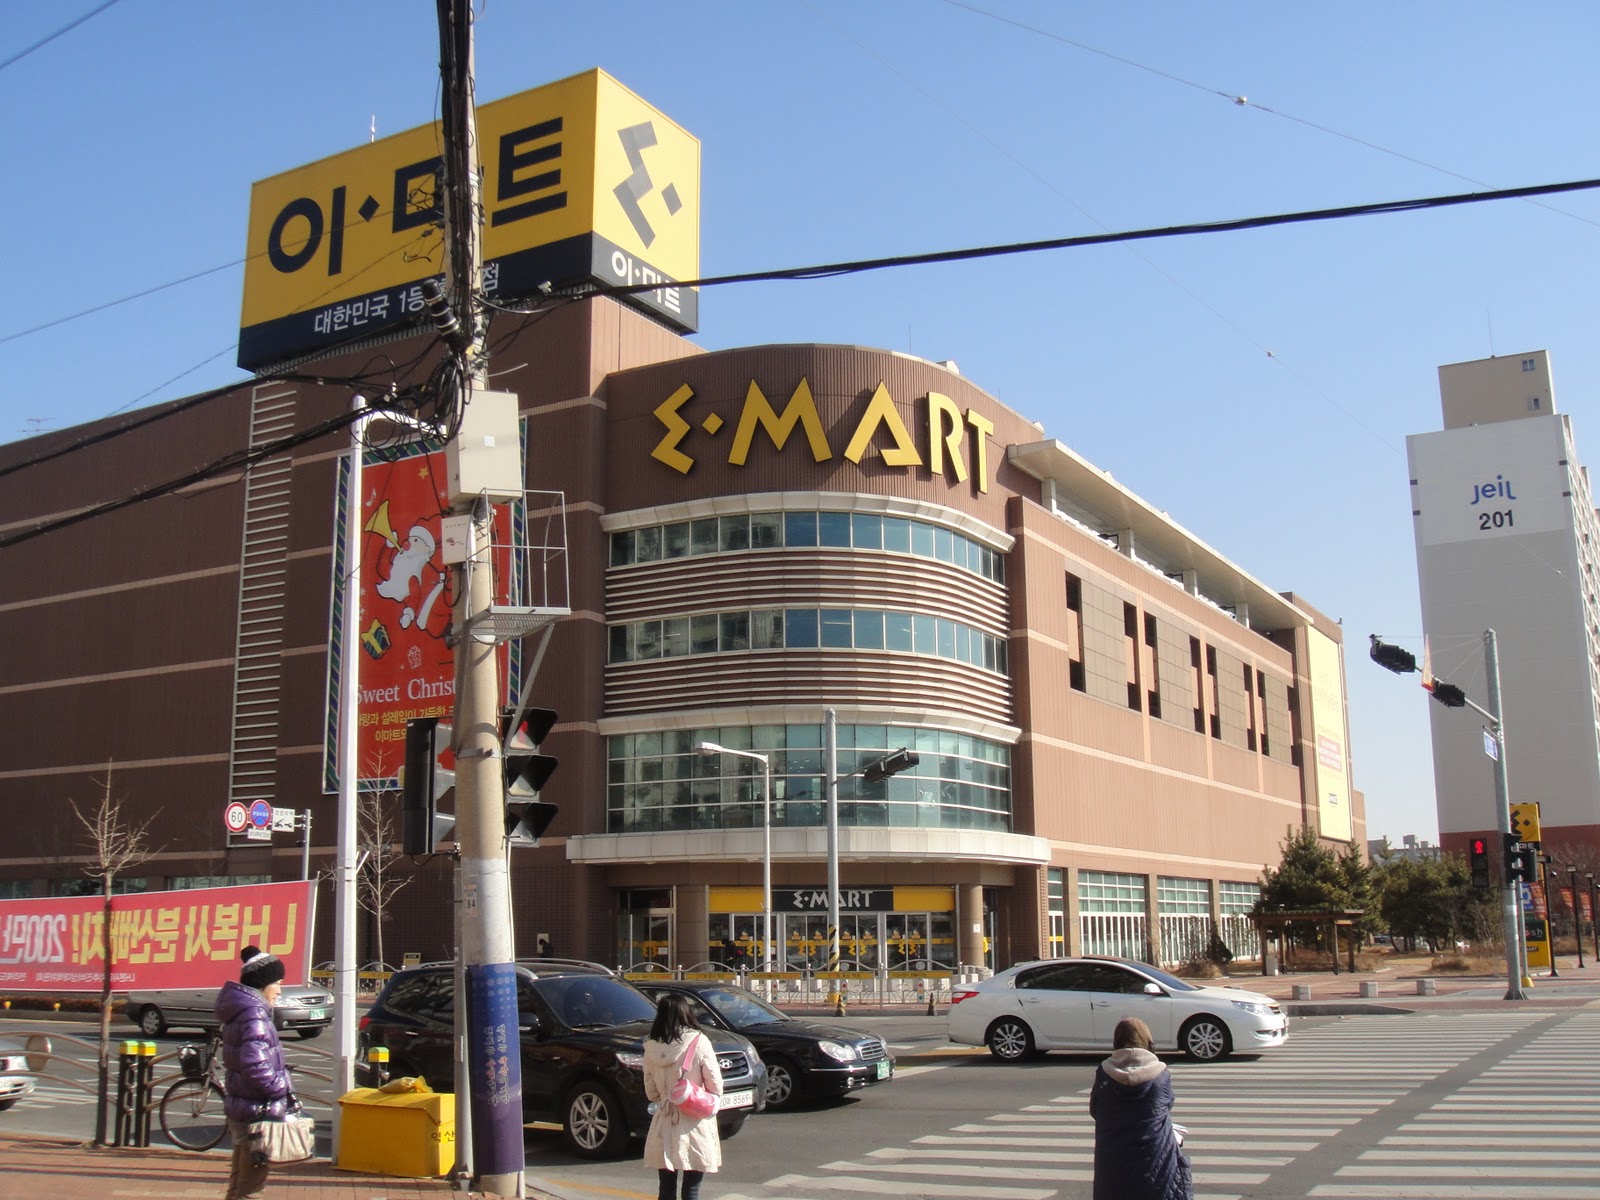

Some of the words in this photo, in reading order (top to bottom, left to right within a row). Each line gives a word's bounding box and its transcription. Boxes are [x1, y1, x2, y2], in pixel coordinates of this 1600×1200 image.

[314, 294, 390, 334] 대한민국
[1479, 510, 1514, 531] 201
[407, 676, 456, 700] Christ
[231, 811, 243, 823] 60
